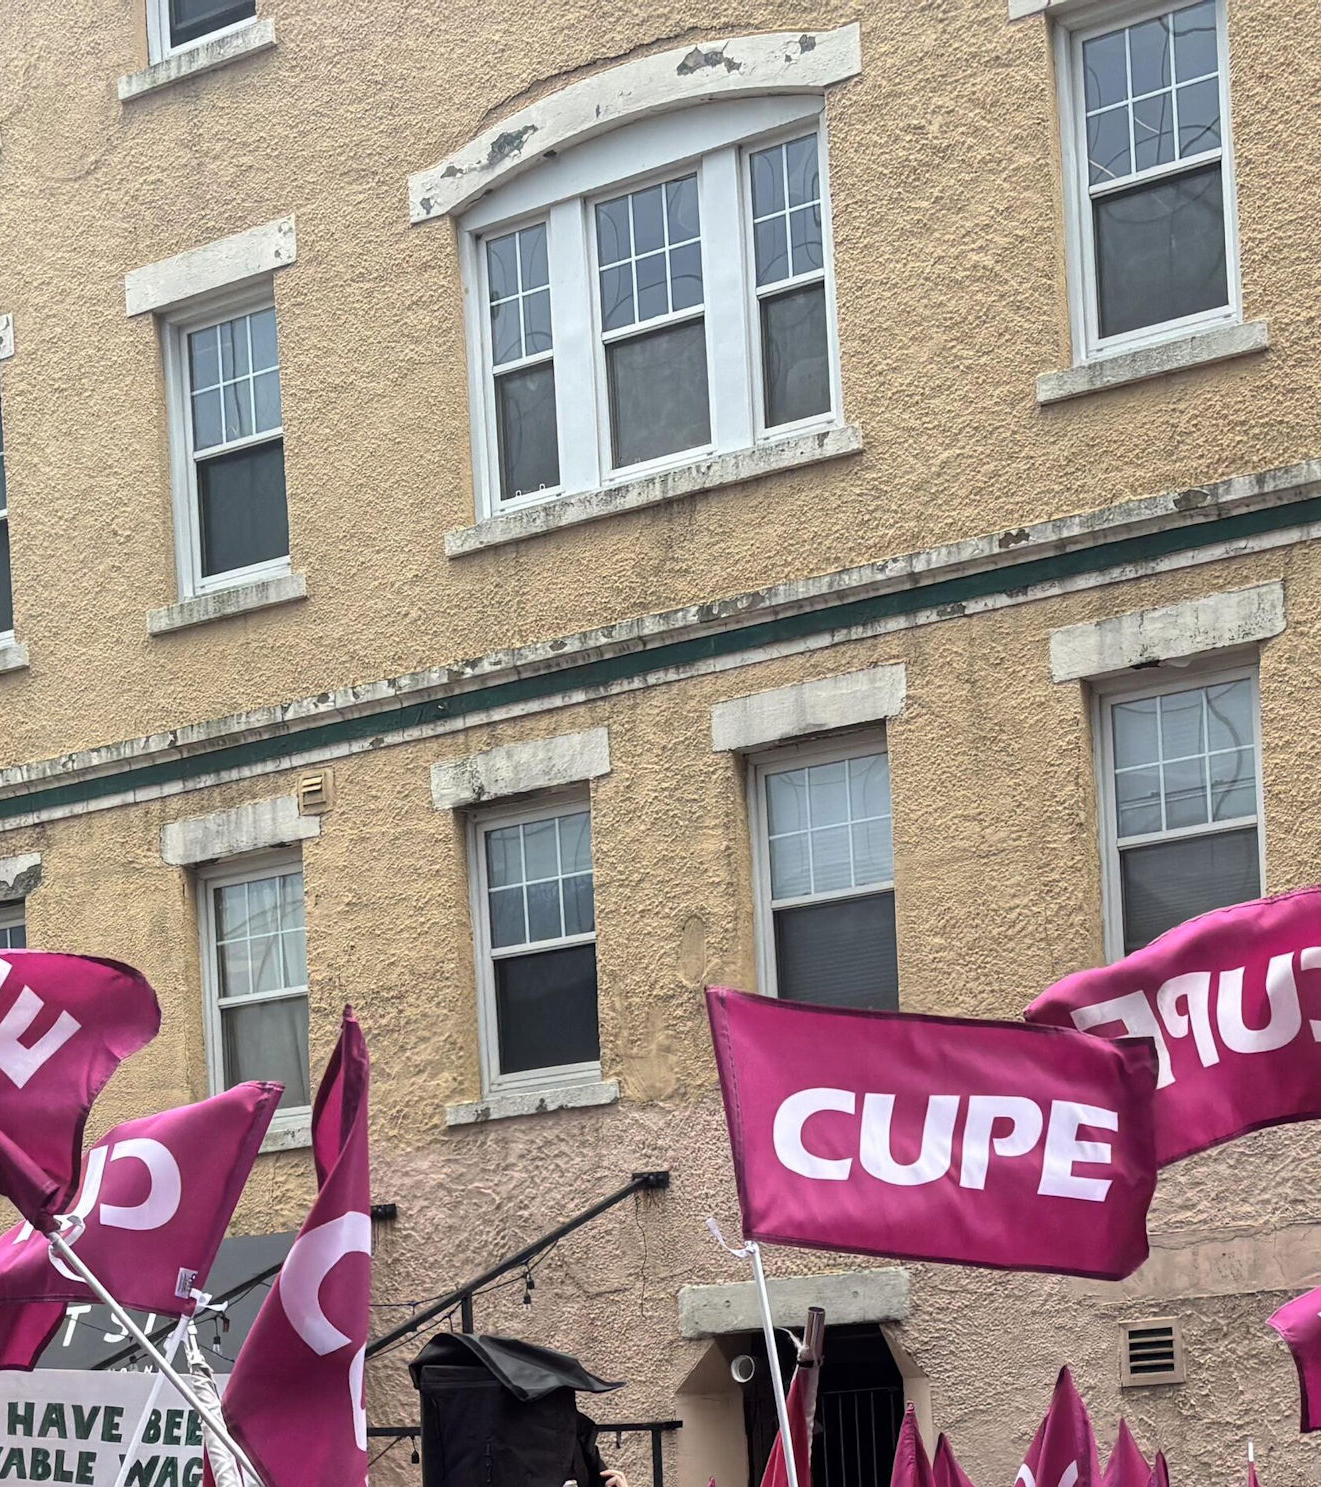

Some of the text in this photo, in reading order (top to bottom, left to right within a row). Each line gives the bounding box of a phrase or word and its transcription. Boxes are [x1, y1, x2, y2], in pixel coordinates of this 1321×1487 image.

[772, 1086, 1118, 1202] CUPE
[7, 1401, 124, 1443] HAVE
[141, 1408, 204, 1446] BEE
